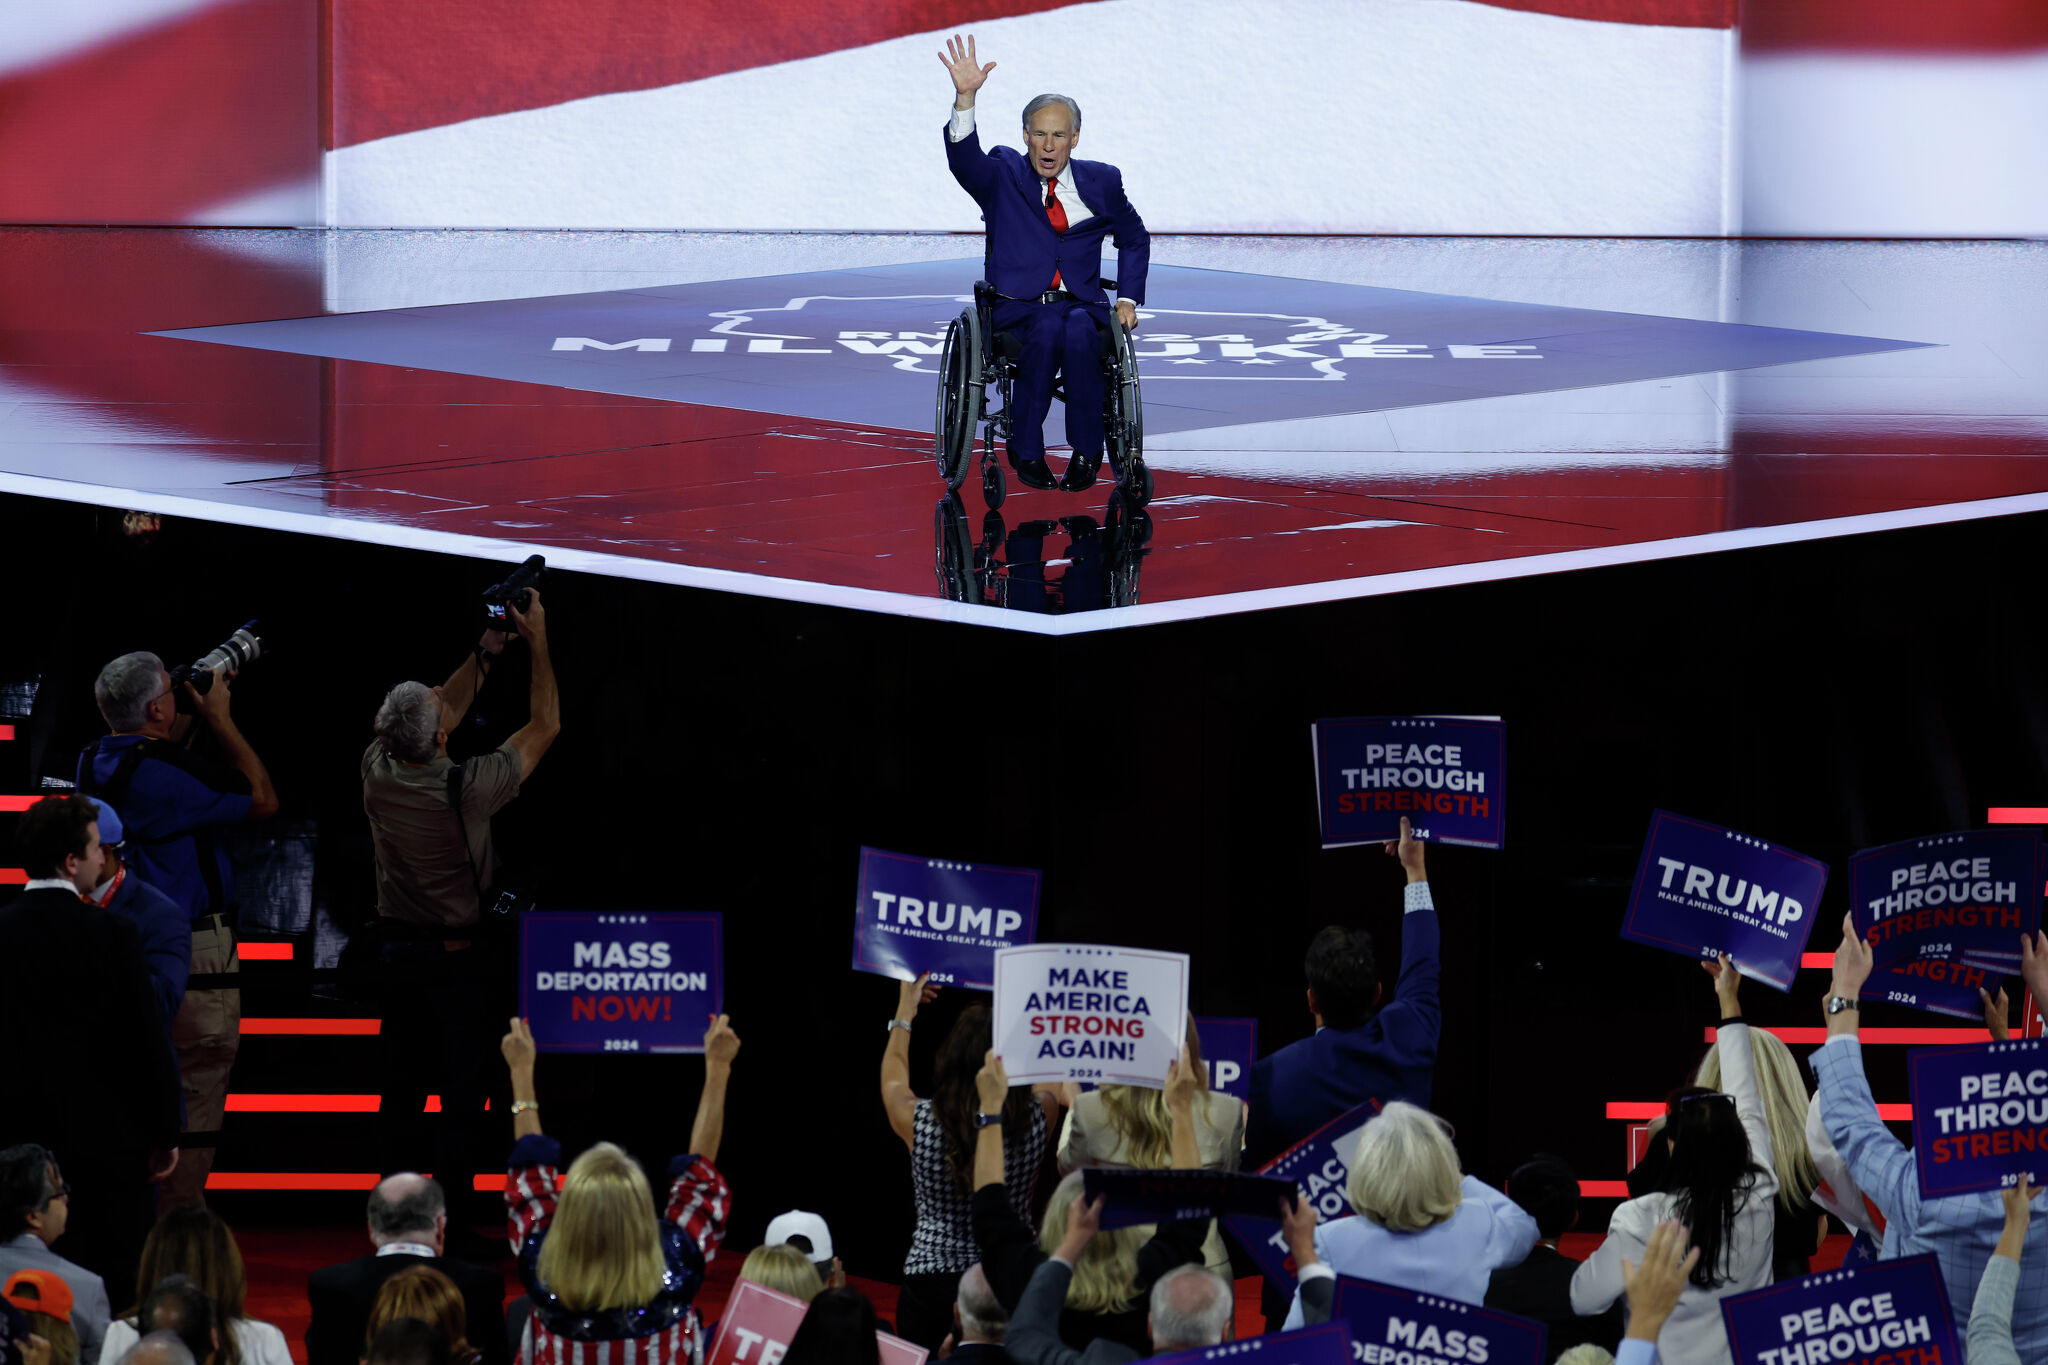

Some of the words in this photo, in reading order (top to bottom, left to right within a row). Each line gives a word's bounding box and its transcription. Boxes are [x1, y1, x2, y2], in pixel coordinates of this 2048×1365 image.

[552, 337, 1544, 358] MILWUKEE
[1366, 743, 1462, 767] PEACE
[1341, 767, 1485, 793] THROUGH
[1337, 791, 1489, 818] STRENGTH
[1410, 828, 1430, 839] 24
[1891, 857, 1991, 891] PEACE
[1658, 856, 1803, 926] TRUMP
[1869, 881, 2016, 921] THROUGH
[872, 891, 1022, 938] TRUMP
[1658, 890, 1685, 905] MAKE
[1687, 899, 1730, 917] AMERICA
[1732, 911, 1760, 928] GREAT
[1761, 922, 1789, 940] AGAIN!
[1866, 906, 2021, 948] STRENGTH
[876, 923, 901, 935] MAKE
[902, 928, 944, 941] AMERICA
[946, 934, 976, 945] GREAT
[978, 938, 1012, 949] AGAIN!
[1920, 943, 1952, 954] 2024
[574, 941, 672, 969] MASS
[1701, 946, 1733, 962] 204
[536, 972, 707, 991] DEPORTATION
[929, 972, 954, 983] 024
[1049, 968, 1129, 990] MAKE
[571, 996, 672, 1022] NOW!
[1024, 992, 1151, 1016] AMERICA
[1888, 991, 1917, 1004] 2024
[1030, 1016, 1144, 1038] STRONG
[603, 1039, 639, 1051] 2024
[1037, 1040, 1135, 1061] AGAIN!
[1069, 1068, 1102, 1078] 2024
[1961, 1070, 2048, 1102] PEAC
[1934, 1098, 2048, 1133] THROU
[2001, 1172, 2035, 1186] 204
[1781, 1292, 1896, 1342] PEACE
[1386, 1316, 1489, 1363] MASS
